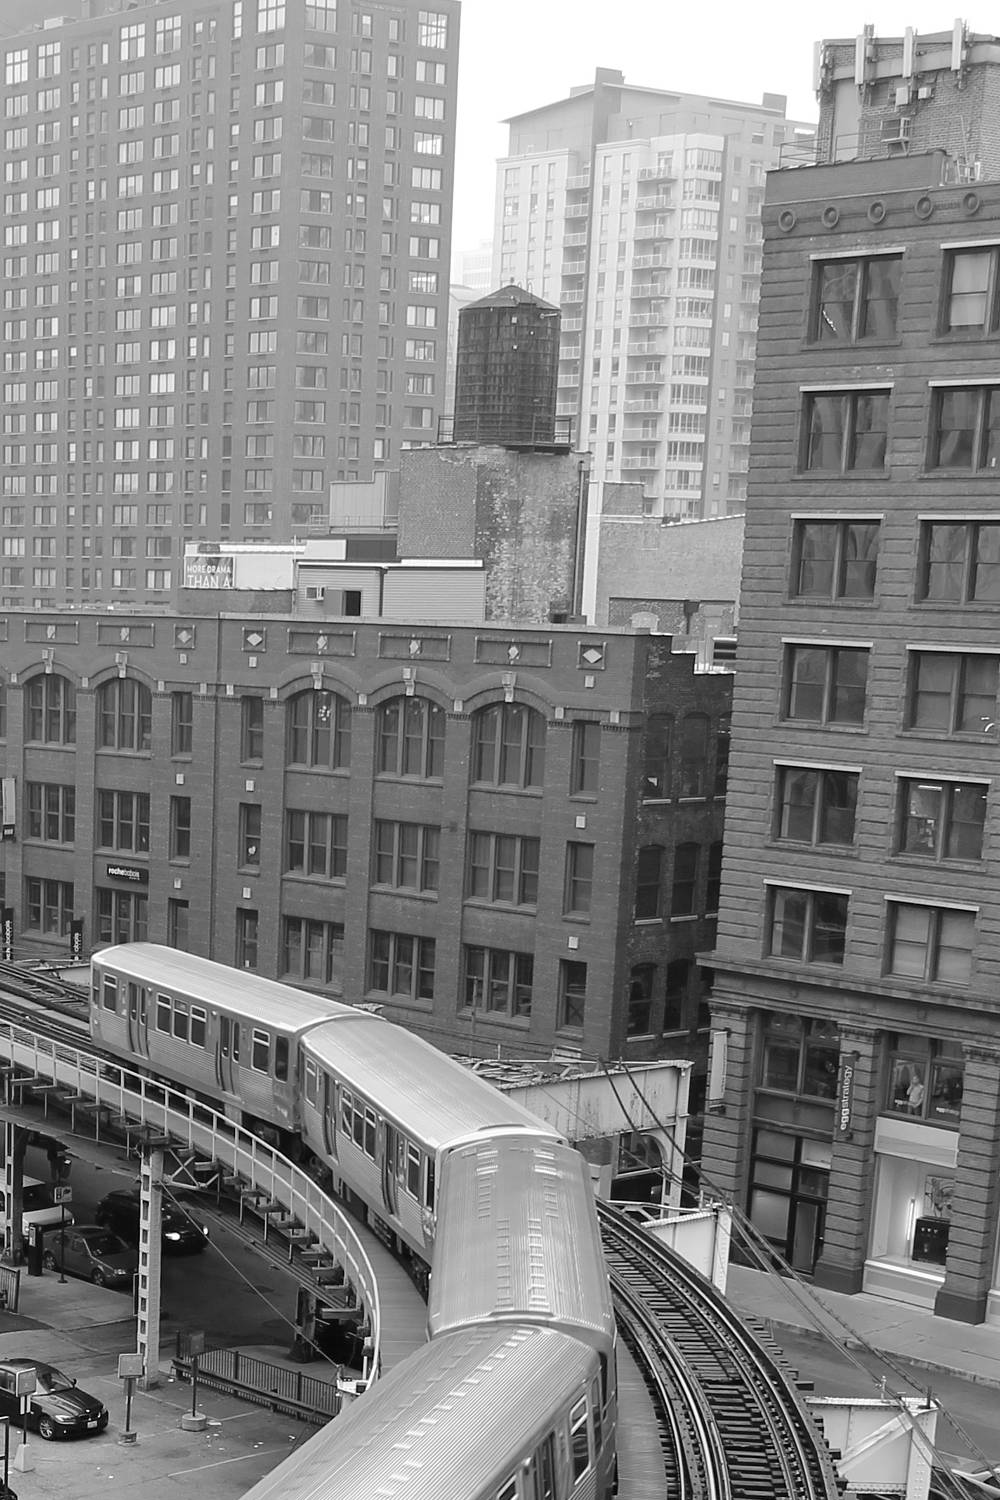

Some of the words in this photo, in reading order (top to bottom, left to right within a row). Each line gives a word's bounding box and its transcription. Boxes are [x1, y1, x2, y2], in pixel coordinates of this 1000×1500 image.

[187, 565, 206, 574] MORE
[207, 565, 231, 574] DRAMA
[187, 575, 219, 588] THAN
[223, 575, 231, 588] A
